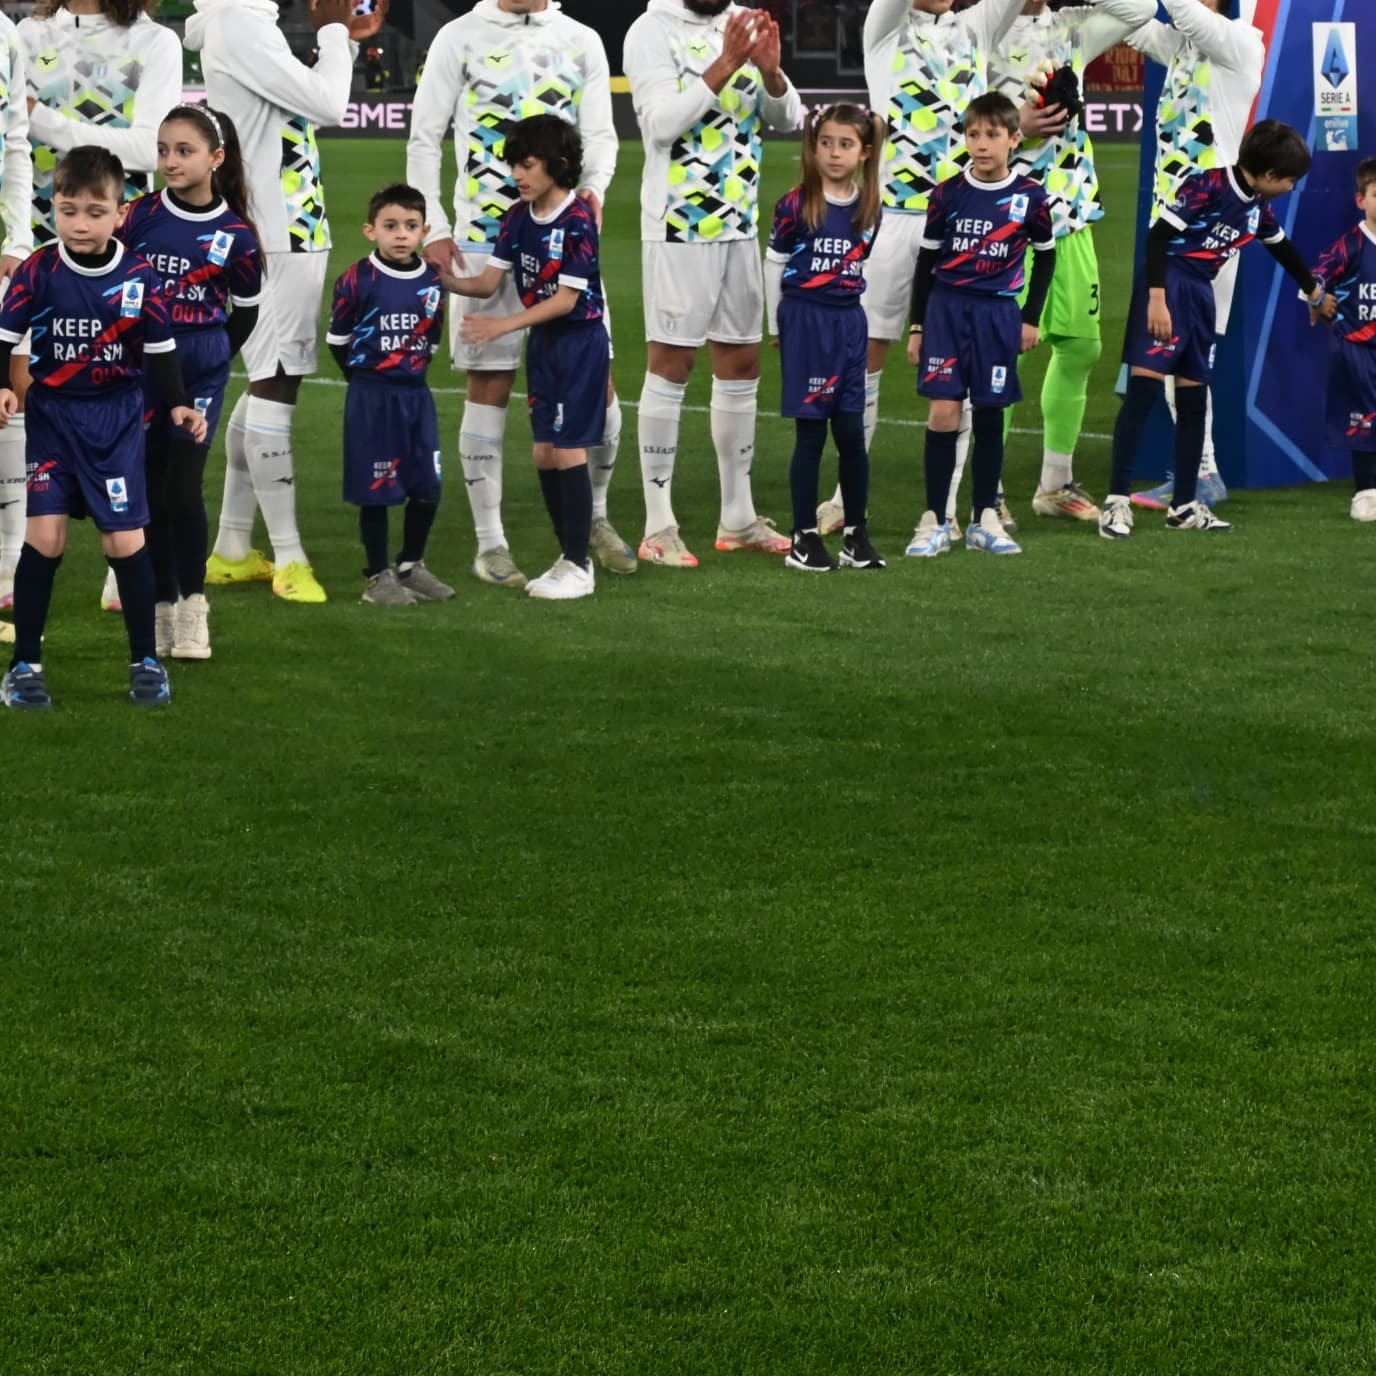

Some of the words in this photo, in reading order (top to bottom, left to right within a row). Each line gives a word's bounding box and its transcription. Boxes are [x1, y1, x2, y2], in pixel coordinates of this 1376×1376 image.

[1321, 92, 1343, 104] SERIE
[1345, 92, 1352, 104] A
[955, 218, 992, 235] KEEP
[813, 237, 852, 255] KEEP
[952, 237, 1008, 258] RACISM
[145, 253, 191, 276] KEEP
[52, 318, 103, 338] KEEP
[379, 313, 421, 331] KEEP
[53, 342, 123, 362] RACISM
